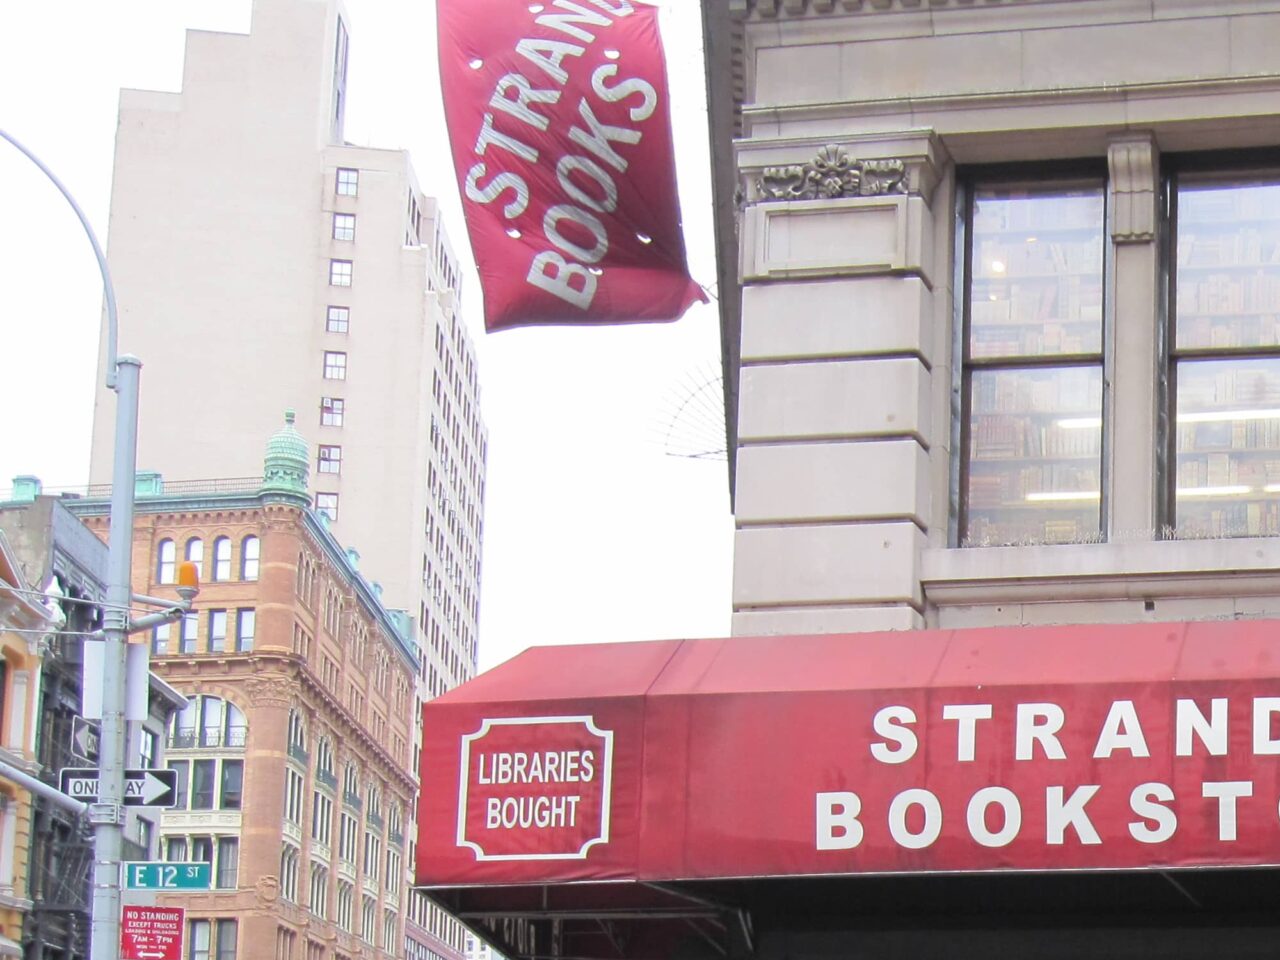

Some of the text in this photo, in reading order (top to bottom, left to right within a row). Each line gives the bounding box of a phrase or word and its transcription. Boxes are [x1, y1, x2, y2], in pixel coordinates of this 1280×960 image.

[465, 0, 634, 219] STRAN
[527, 63, 657, 311] BOOKS
[478, 749, 594, 785] LIBRARIES
[125, 781, 145, 795] AY
[486, 796, 580, 830] BOUGHT
[135, 866, 200, 887] E 12 ST
[127, 911, 179, 921] NO STANDING
[131, 935, 148, 943] 7AM
